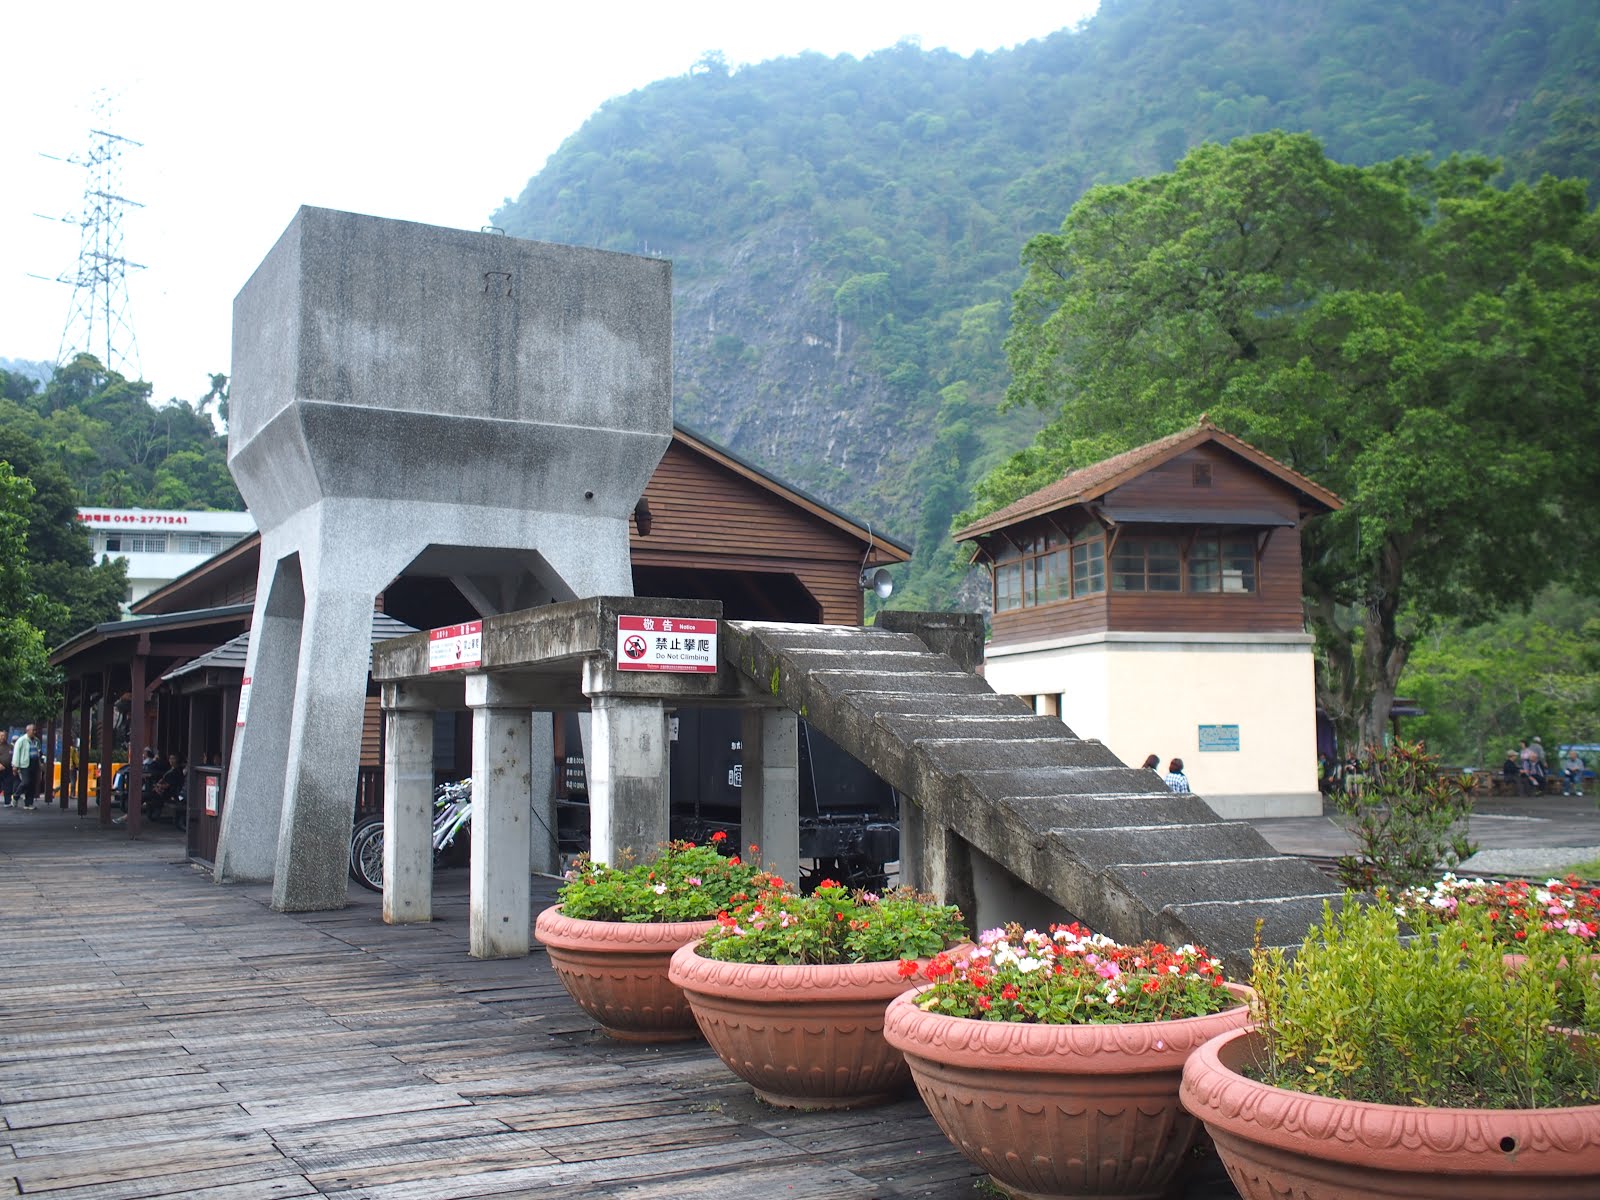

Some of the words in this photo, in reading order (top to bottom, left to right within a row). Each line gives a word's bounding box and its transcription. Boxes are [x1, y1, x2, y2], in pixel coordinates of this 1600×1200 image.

[114, 515, 187, 524] 049-2771241
[643, 618, 673, 631] 敬告
[655, 637, 709, 652] 禁止攀爬
[680, 653, 709, 662] Climbing
